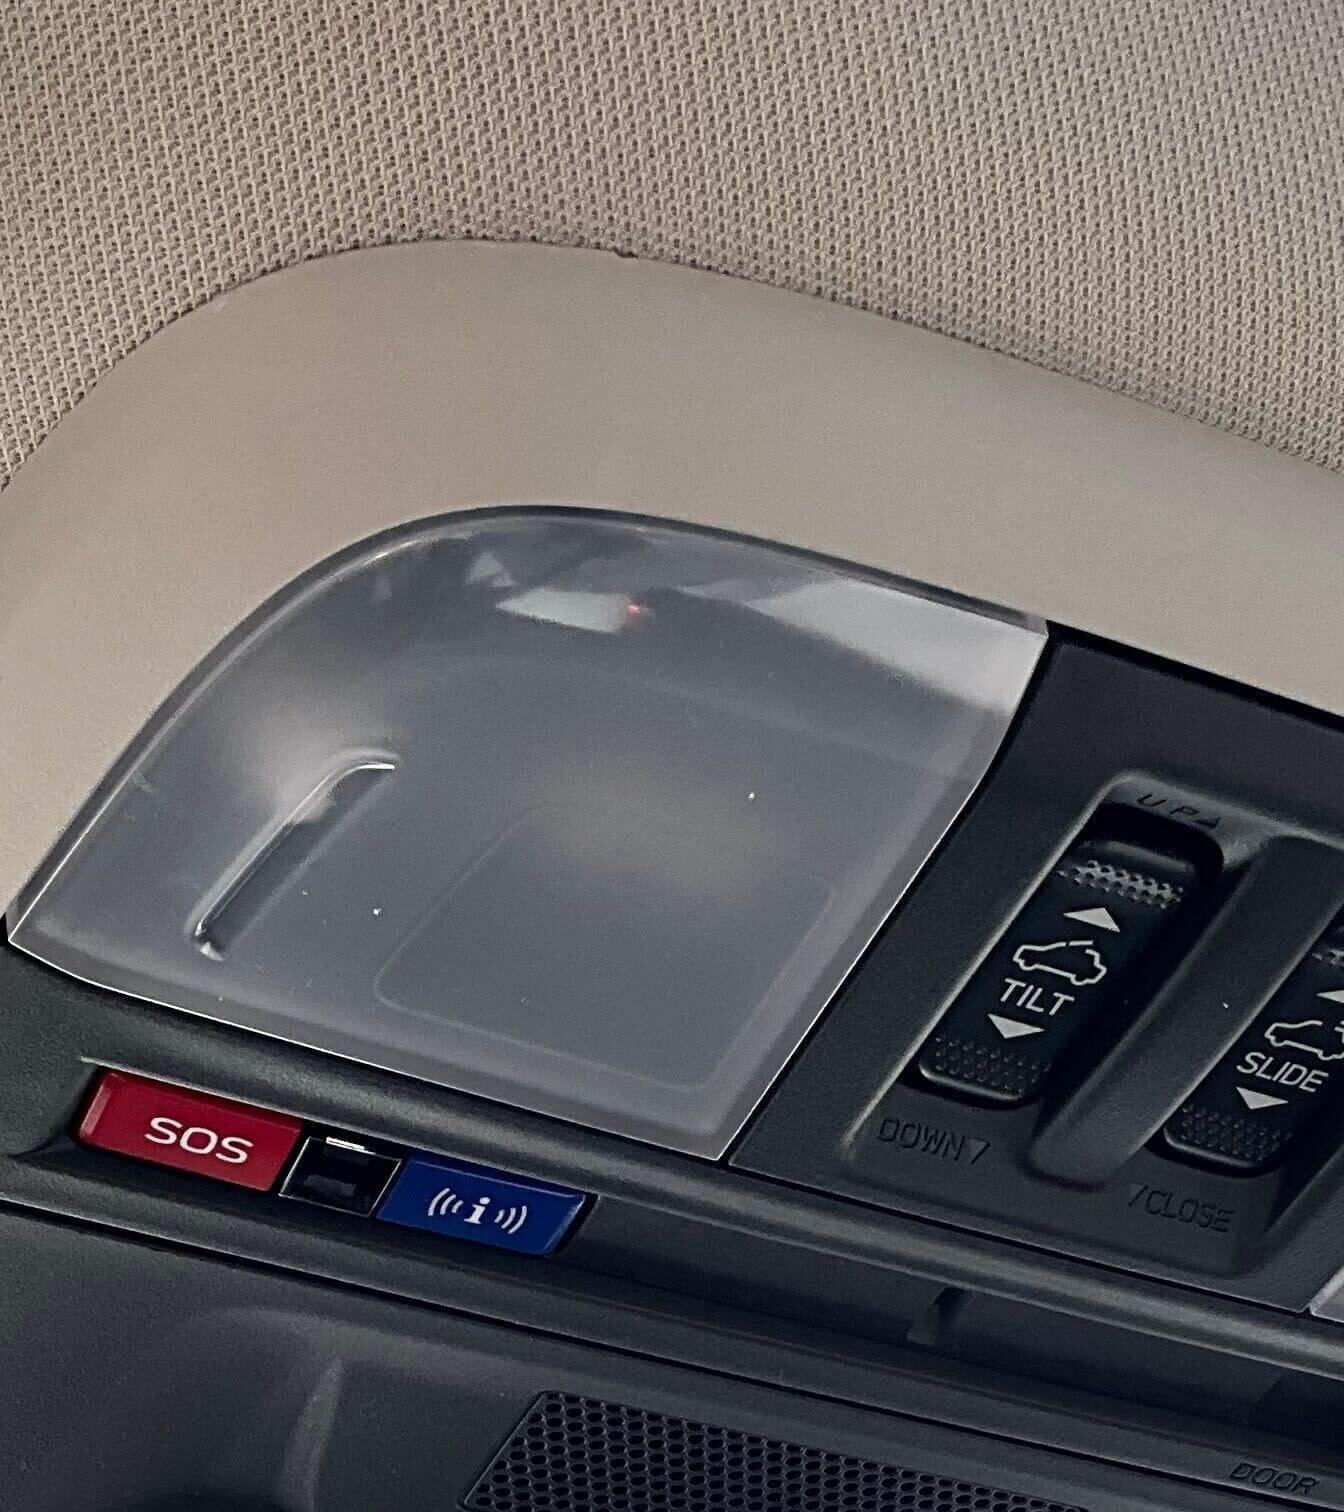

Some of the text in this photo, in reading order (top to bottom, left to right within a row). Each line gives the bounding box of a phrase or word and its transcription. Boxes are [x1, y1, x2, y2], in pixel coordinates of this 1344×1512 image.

[1136, 793, 1199, 818] UP
[999, 977, 1075, 1016] TILT
[1236, 1052, 1329, 1093] SLIDE
[144, 1116, 254, 1165] SOS
[876, 1117, 967, 1163] DOWN
[1145, 1189, 1236, 1234] CLOSE
[1228, 1461, 1320, 1497] DOOR
